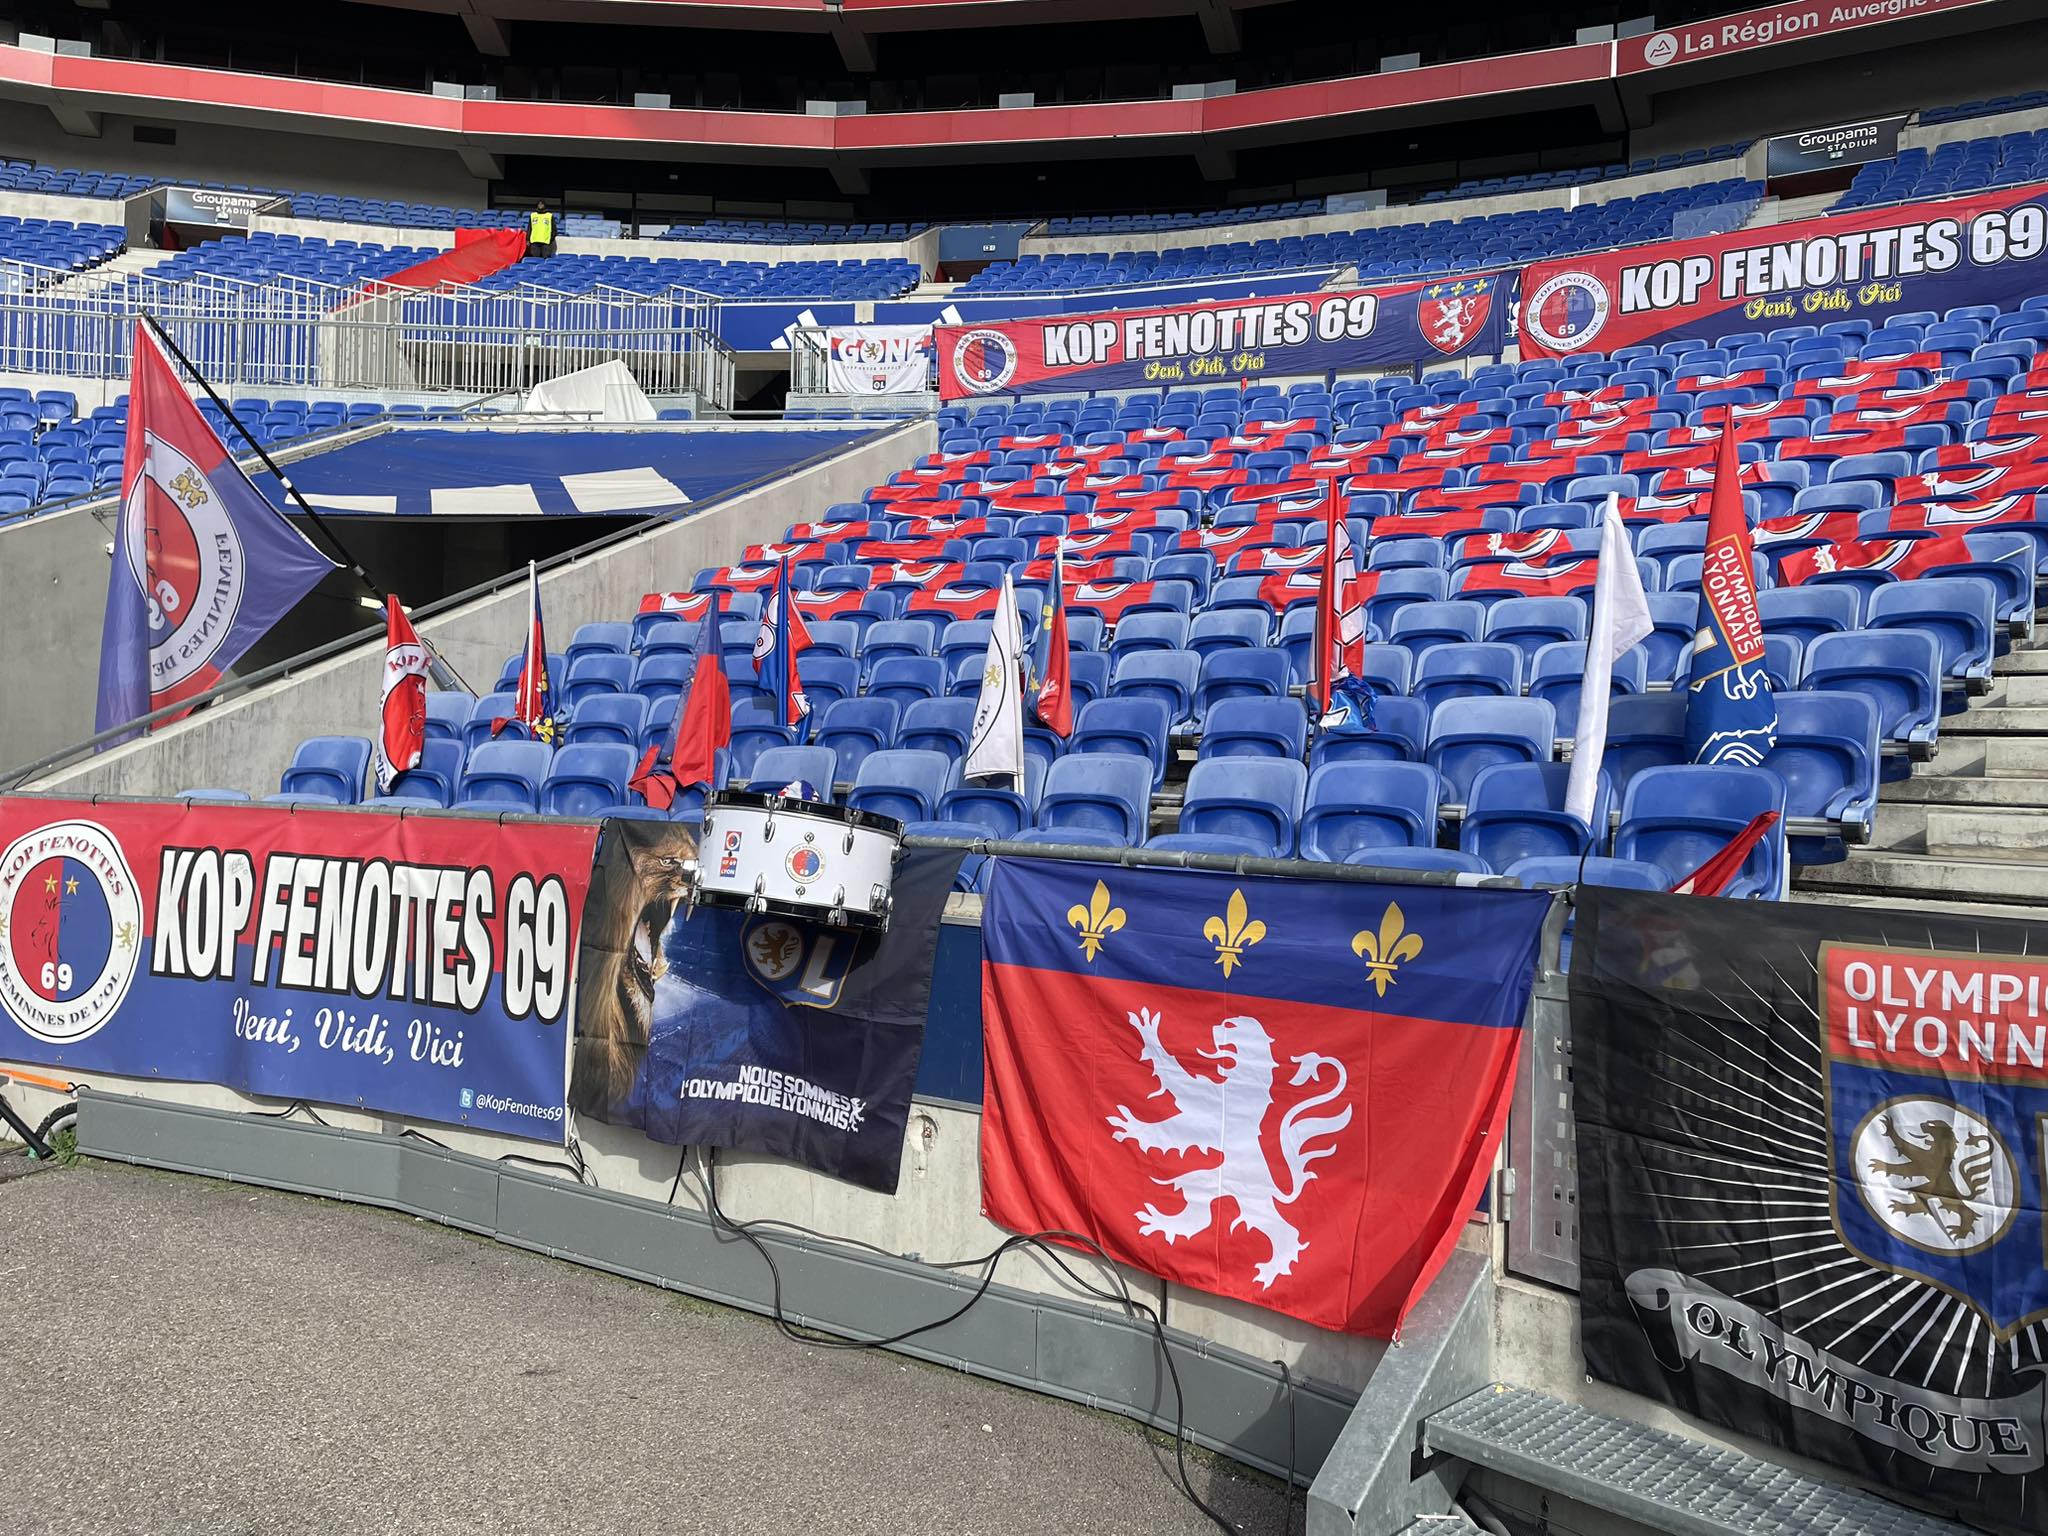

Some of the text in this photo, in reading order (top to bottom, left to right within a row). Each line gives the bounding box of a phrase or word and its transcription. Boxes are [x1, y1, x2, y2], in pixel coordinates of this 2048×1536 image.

[1684, 32, 1715, 54] La
[1721, 9, 1820, 46] Région
[1799, 126, 1878, 147] Groupama
[1827, 138, 1878, 152] STADIUM
[192, 192, 257, 207] Groupama
[1621, 257, 1712, 313] KOP
[1721, 218, 1961, 298] FENOTTES
[1970, 205, 2047, 264] 69
[1043, 294, 1379, 367] KOP FENOTTES 69
[1558, 323, 1576, 335] 69
[977, 369, 992, 379] 69
[1703, 553, 1754, 656] LYONNAIS
[1718, 545, 1765, 649] OLYMPIQUE
[3, 836, 124, 897] KOP FENOTTES
[151, 847, 570, 1023] KOP FENOTTES 69
[0, 961, 122, 1026] FEMININES DE L'OL
[41, 961, 73, 992] 69
[1844, 961, 2048, 1018] OLYMPI
[233, 997, 464, 1068] Veni, Vidi, Vici
[1847, 1006, 2047, 1069] LYONN
[475, 1093, 564, 1122] @KopFenottes69
[739, 1064, 850, 1111] NOUS SOMMES
[1683, 1301, 2031, 1457] OLYMPIQUE
